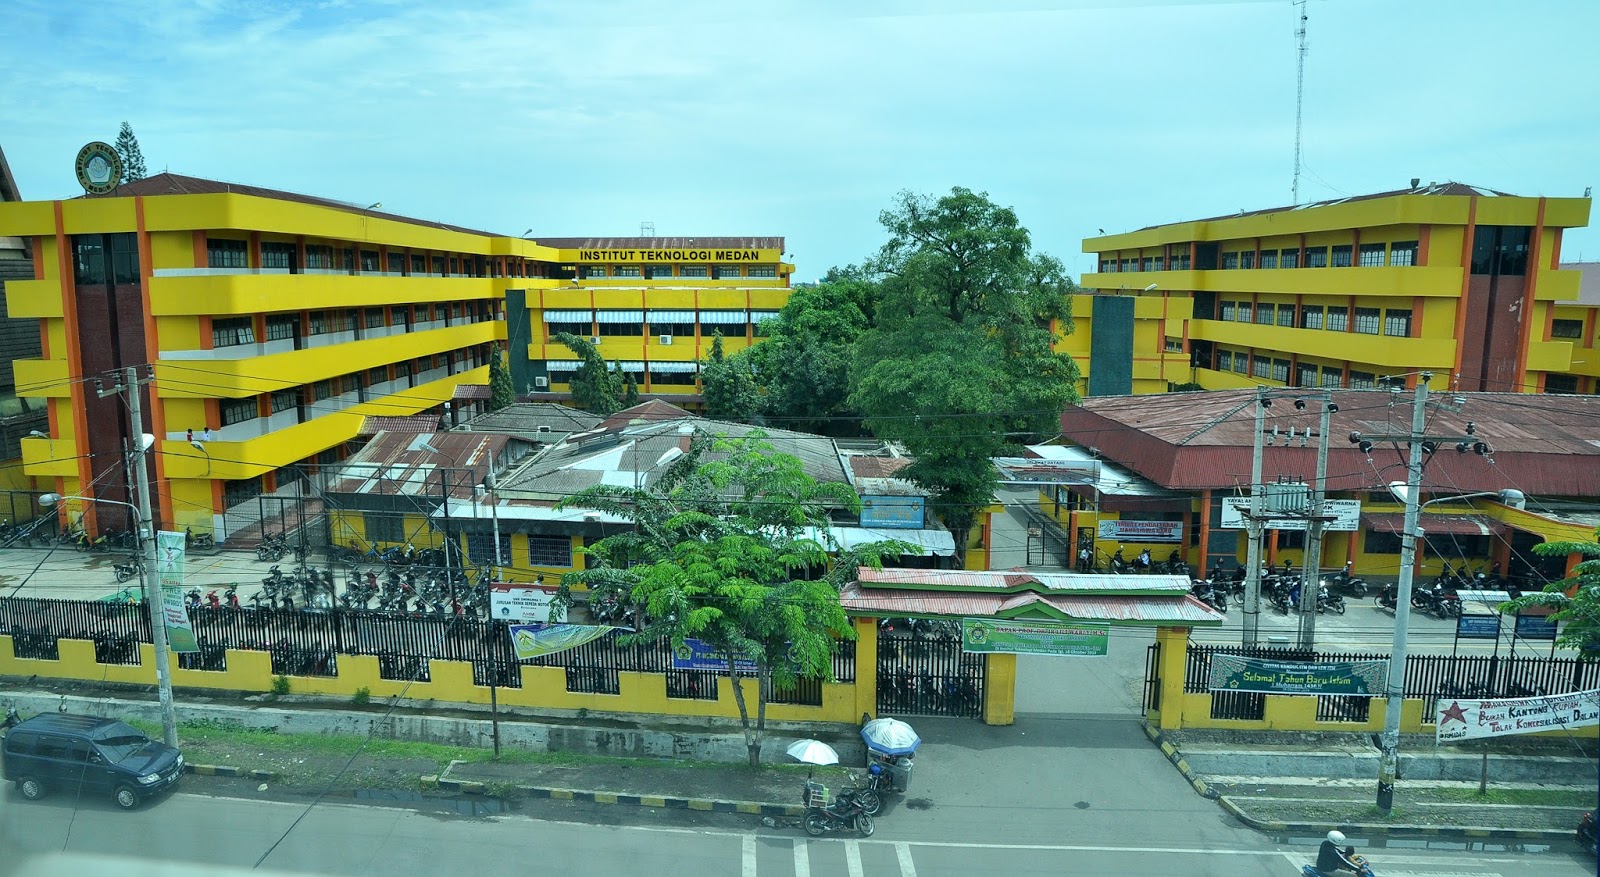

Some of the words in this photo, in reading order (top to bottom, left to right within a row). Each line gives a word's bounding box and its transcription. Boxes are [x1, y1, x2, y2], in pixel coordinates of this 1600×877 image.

[580, 251, 635, 260] INSTITUT
[640, 251, 711, 260] TEKNOLOGI
[715, 251, 759, 260] MEDAN
[1243, 671, 1275, 683] Selamat
[1279, 674, 1304, 684] Tahun
[1306, 675, 1327, 684] Baru
[1329, 675, 1351, 685] Islam
